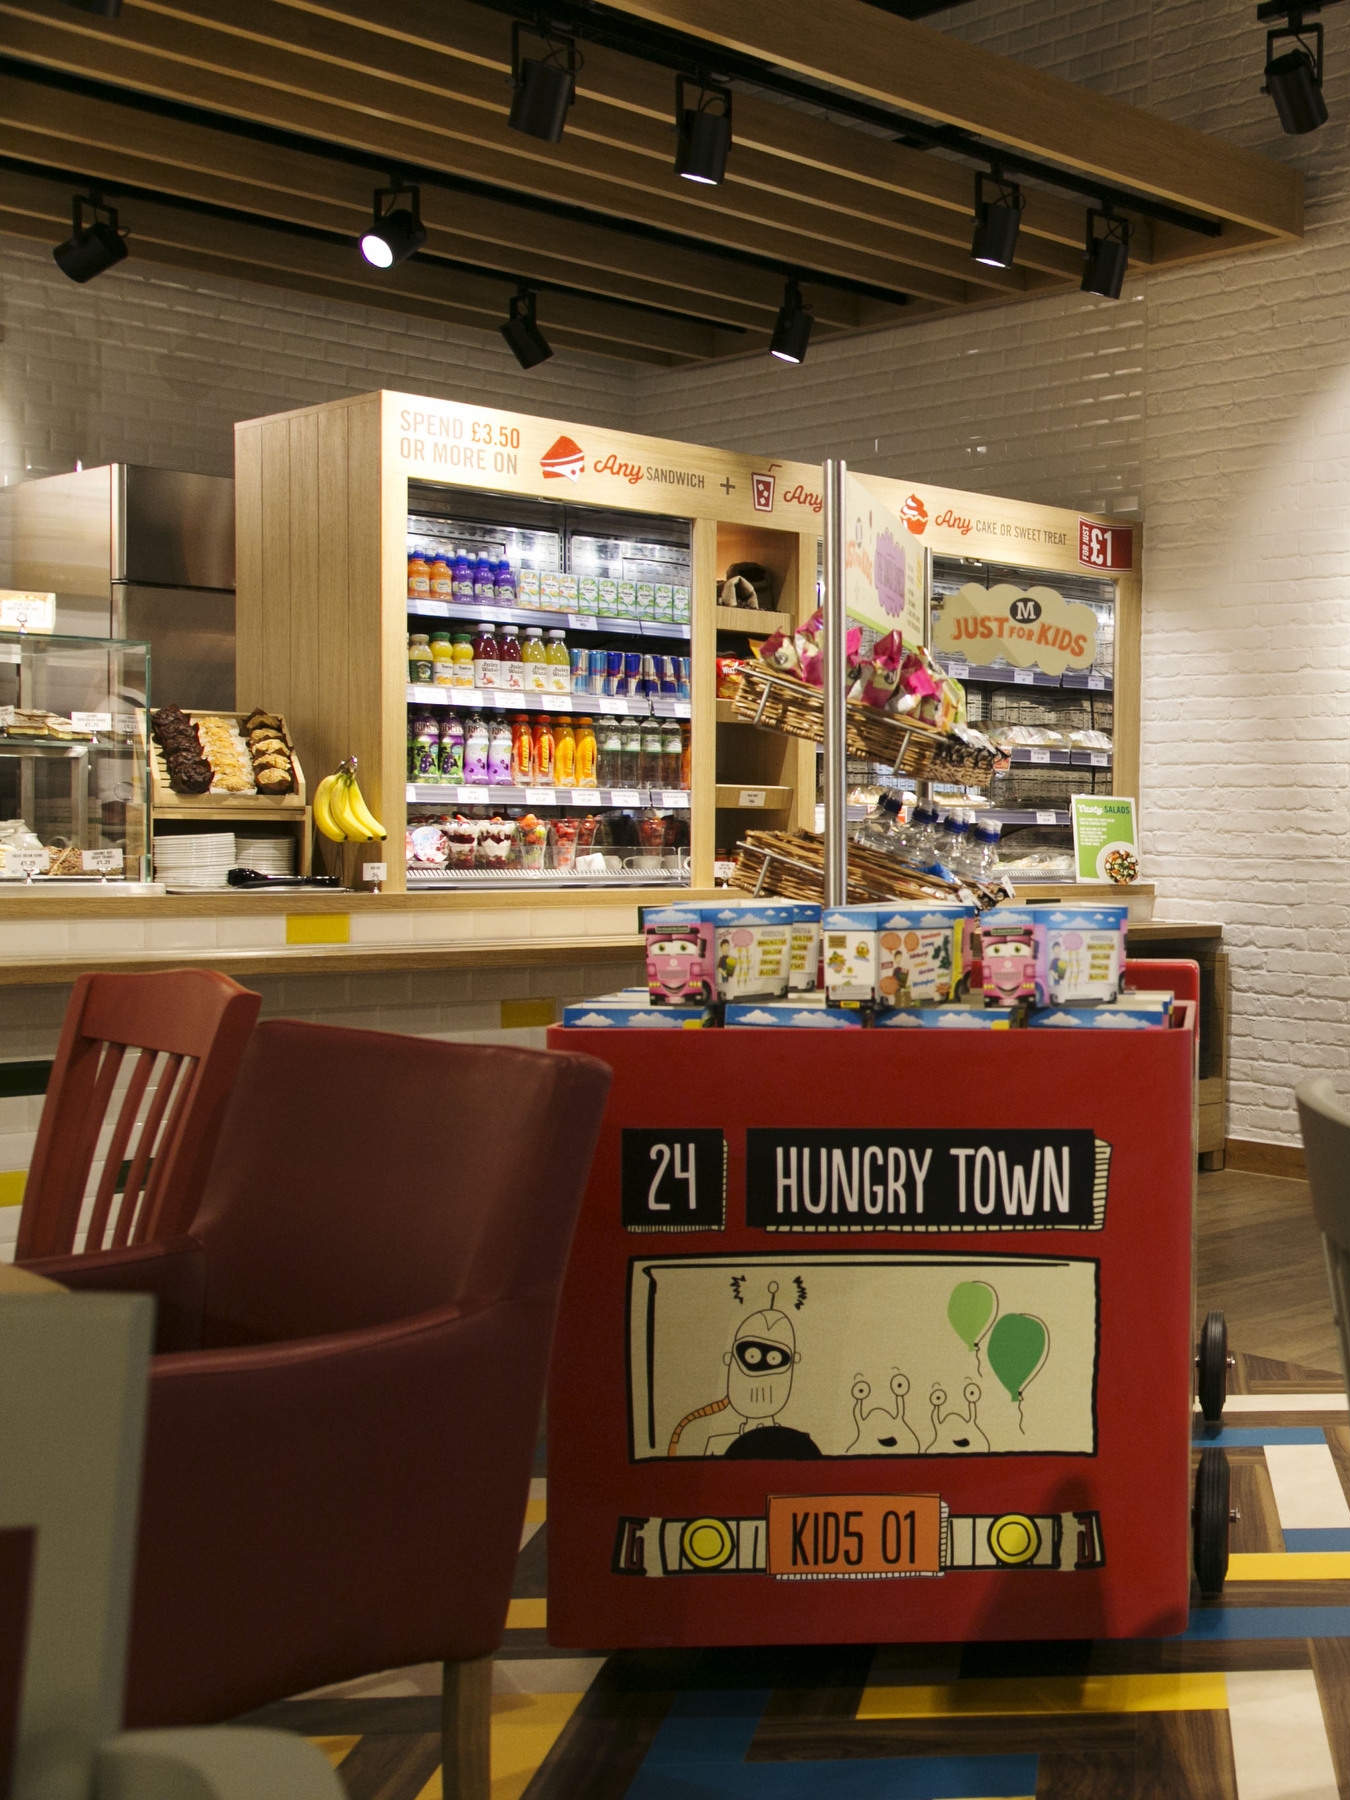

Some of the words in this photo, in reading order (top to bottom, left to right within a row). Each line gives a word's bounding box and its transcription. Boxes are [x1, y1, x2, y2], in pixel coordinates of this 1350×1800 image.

[400, 409, 464, 440] SPEND
[471, 421, 520, 449] £3.50
[400, 436, 425, 460] OR
[433, 442, 486, 470] MORE
[494, 451, 518, 475] ON
[593, 453, 645, 485] Any
[646, 466, 706, 489] SANDWICH
[783, 484, 823, 513] Any
[935, 510, 973, 536] Any
[975, 520, 997, 535] CAKE
[1000, 523, 1012, 537] OR
[1014, 526, 1042, 542] SWEET
[1043, 530, 1067, 545] TREAT
[1082, 525, 1090, 544] JUST
[1090, 527, 1113, 567] £1
[1016, 601, 1037, 620] M
[952, 616, 1009, 641] JUST
[1008, 625, 1036, 642] FOR
[1036, 622, 1088, 657] KIDS
[520, 734, 529, 772] Lucozad
[540, 734, 549, 773] Lucozad
[1077, 804, 1104, 816] Tasty
[1104, 805, 1131, 815] SALADS
[647, 1142, 697, 1211] 24
[775, 1145, 933, 1215] HUNGRY
[950, 1145, 1071, 1215] TOWN
[882, 1511, 918, 1564] 01
